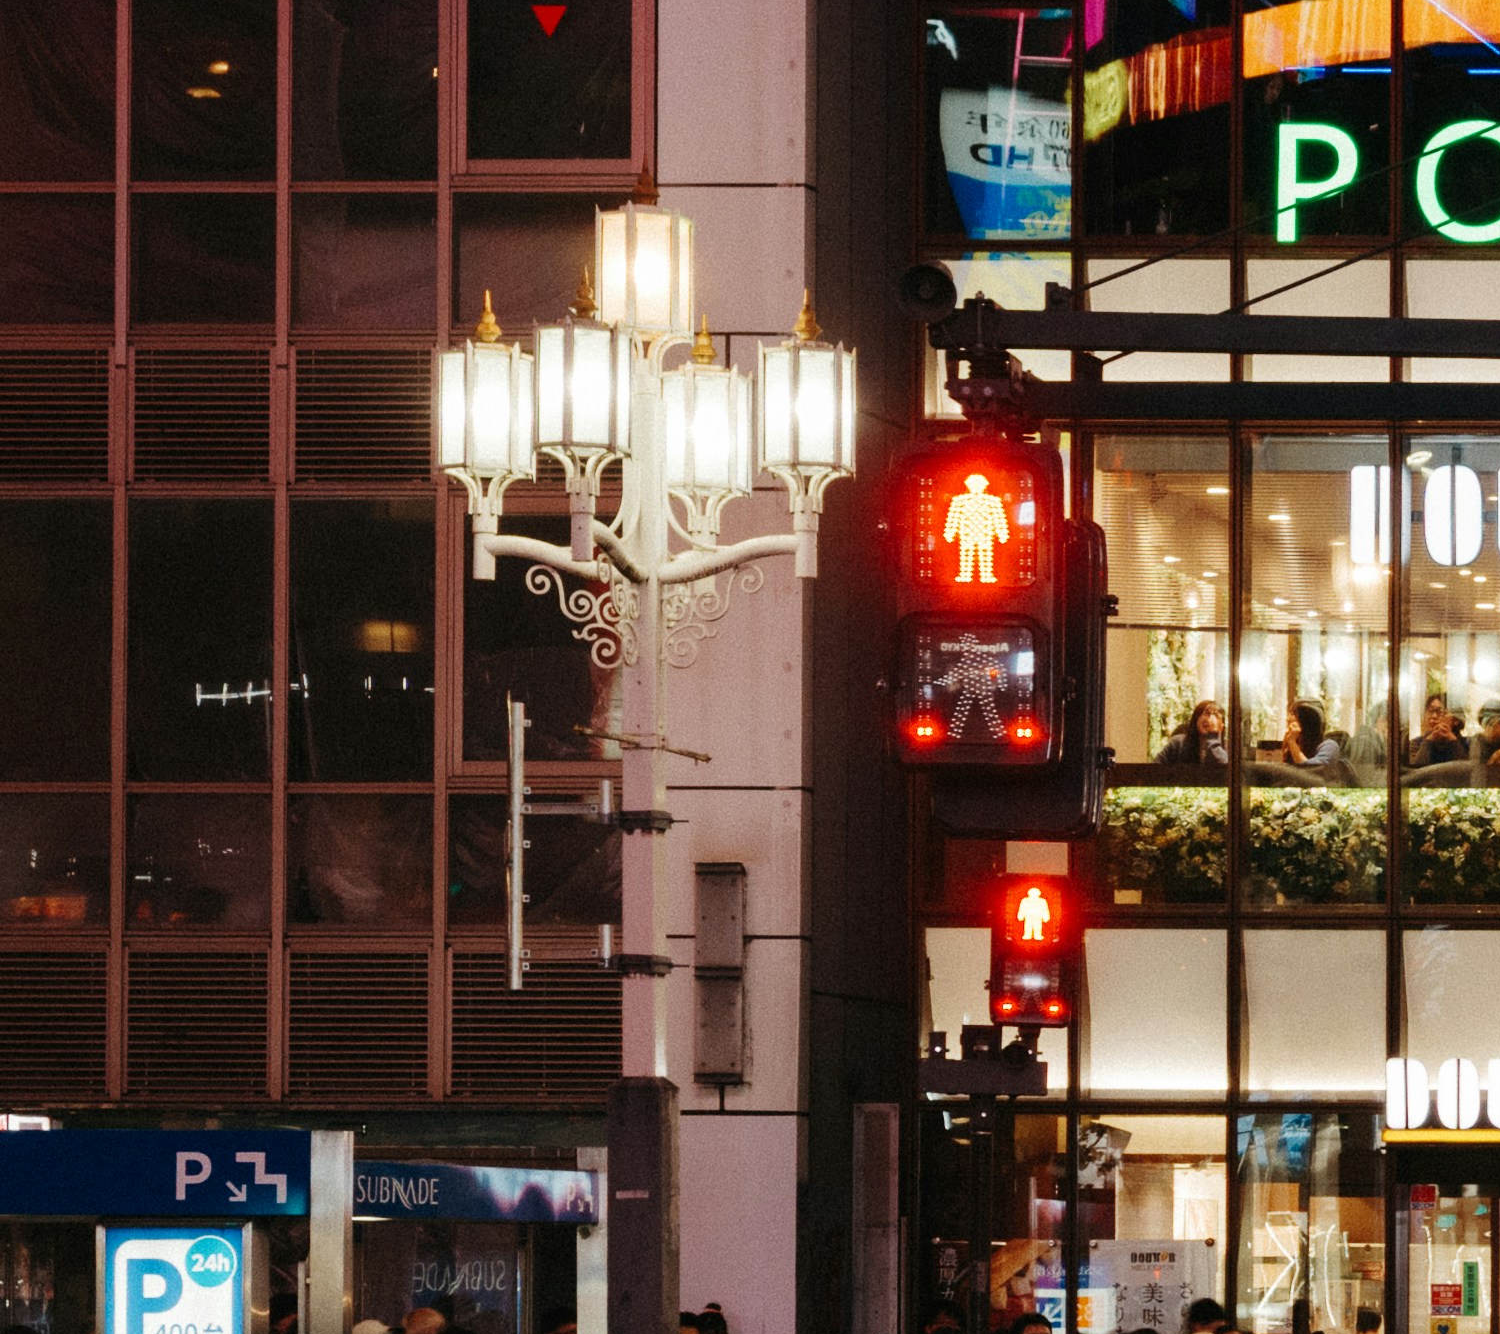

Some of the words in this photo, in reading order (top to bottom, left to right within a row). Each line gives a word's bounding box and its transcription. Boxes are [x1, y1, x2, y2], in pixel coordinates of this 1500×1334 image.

[175, 1151, 212, 1201] P
[355, 1175, 440, 1209] SUBNADE
[190, 1253, 230, 1274] 24h
[1130, 1251, 1176, 1264] DOUTOR
